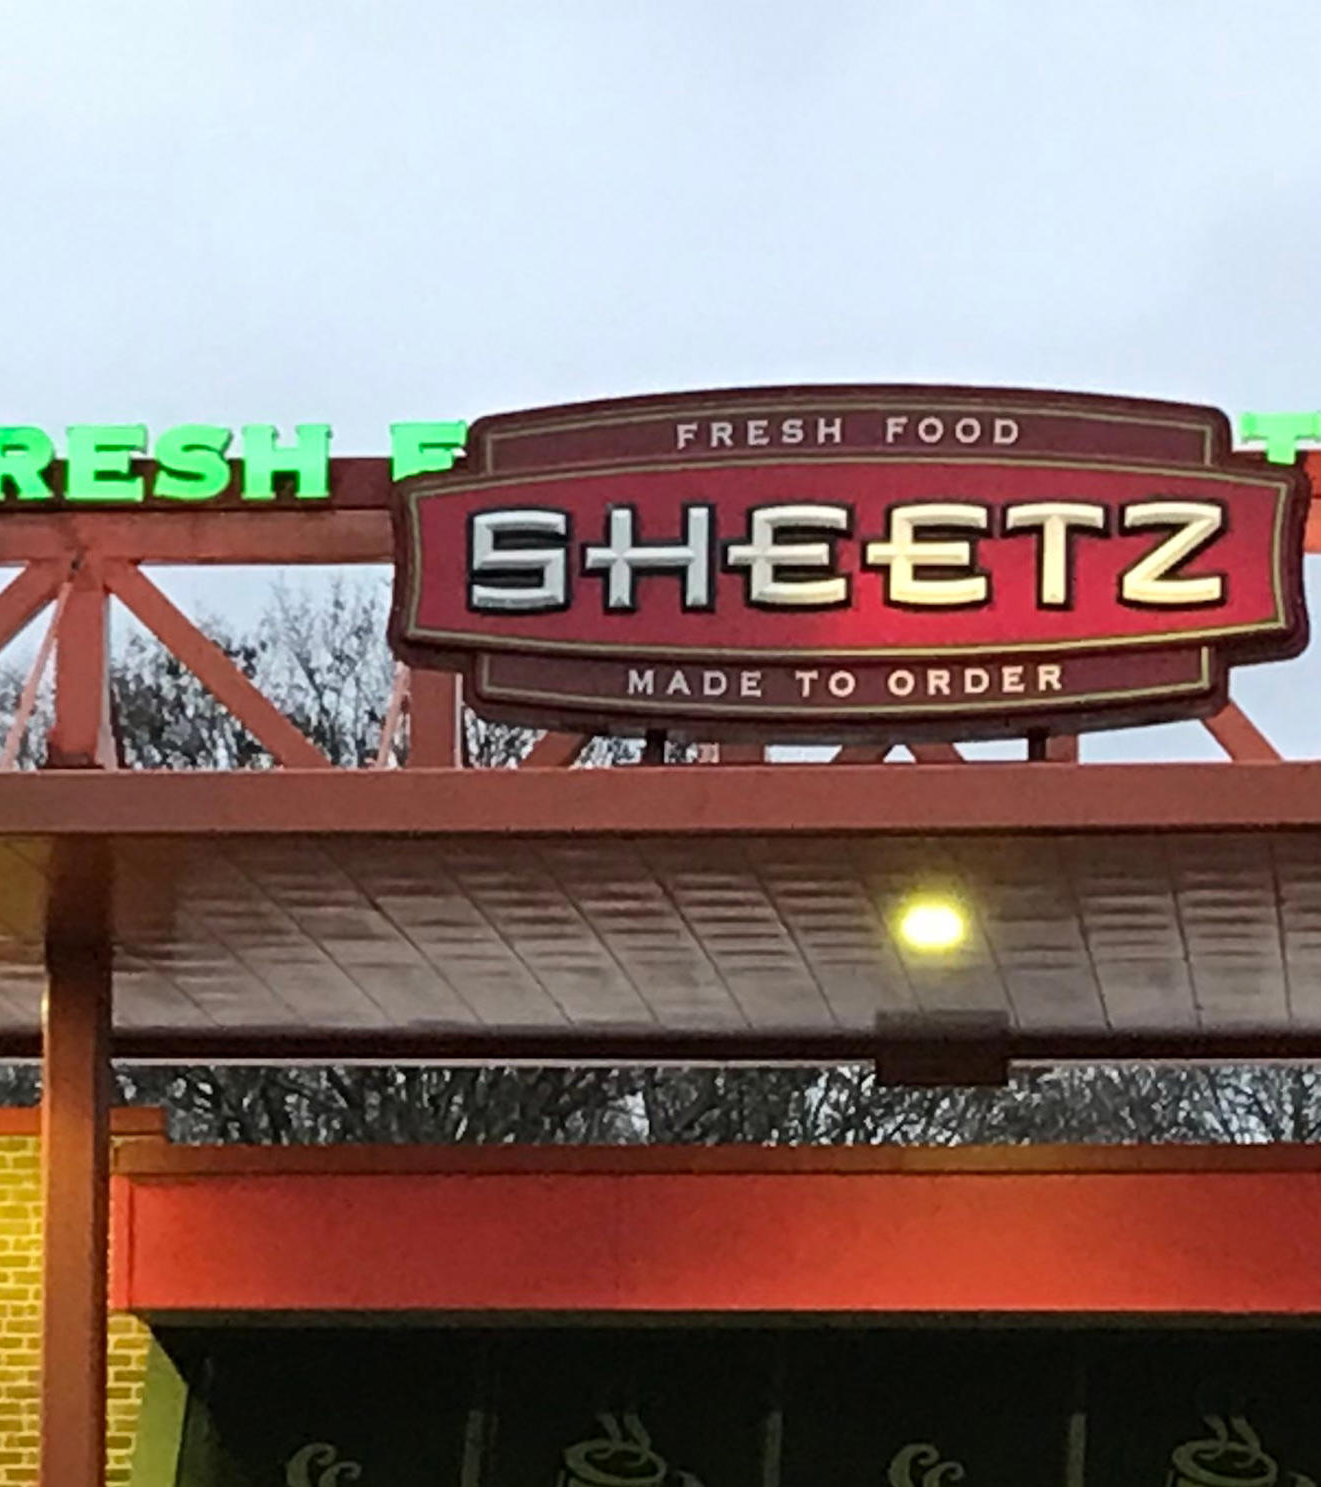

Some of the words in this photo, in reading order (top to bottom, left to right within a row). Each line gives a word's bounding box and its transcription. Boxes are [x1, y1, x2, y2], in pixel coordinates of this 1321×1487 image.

[389, 420, 469, 481] F
[676, 418, 842, 449] FRESH
[886, 416, 1019, 444] FOOD
[471, 502, 1224, 609] SHEETZ
[627, 669, 763, 697] MADE
[795, 670, 857, 697] TO
[886, 664, 1062, 697] ORDER
